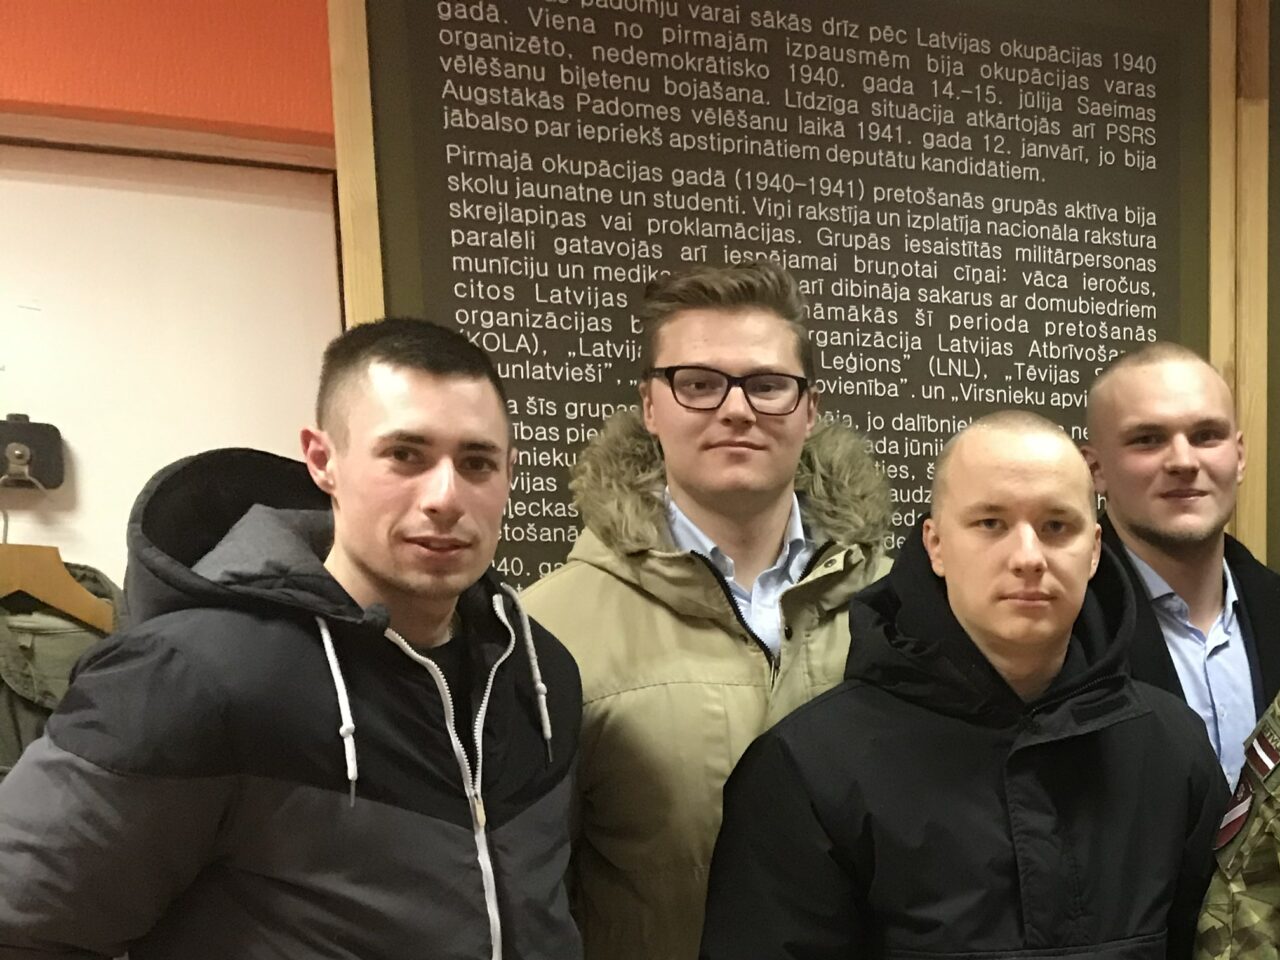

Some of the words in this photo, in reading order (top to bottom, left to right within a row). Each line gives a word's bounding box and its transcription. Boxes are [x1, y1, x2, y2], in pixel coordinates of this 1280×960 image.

[437, 0, 508, 24] gadā.
[528, 7, 596, 34] Viena
[615, 21, 643, 39] no
[663, 24, 767, 53] pirmajām
[786, 37, 909, 70] izpausmēm
[927, 54, 964, 77] bija
[980, 61, 1089, 90] okupācijas
[1104, 79, 1156, 98] varas
[688, 4, 740, 24] varai
[751, 10, 812, 33] sākās
[822, 17, 859, 38] drīz
[870, 25, 907, 44] pēc
[917, 28, 991, 54] Latvijas
[1000, 39, 1102, 68] okupācijas
[1114, 52, 1156, 74] 1940
[439, 29, 572, 59] organizēto,
[592, 45, 770, 79] nedemokrātisko
[789, 63, 845, 88] 1940.
[863, 75, 914, 95] gada
[932, 79, 1002, 104] 14.–15.
[1018, 88, 1062, 113] jūlija
[1078, 96, 1156, 122] Saeimas
[440, 54, 545, 82] vēlēšanu
[560, 64, 649, 93] biļetenu
[664, 75, 770, 105] bojāšana.
[785, 88, 859, 116] Līdzīga
[872, 98, 955, 126] situācija
[966, 109, 1060, 136] atkārtojās
[1072, 123, 1096, 139] arī
[1107, 123, 1156, 145] PSRS
[442, 79, 564, 111] Augstākās
[577, 92, 681, 122] Padomes
[691, 107, 787, 132] vēlēšanu
[798, 115, 845, 138] laikā
[858, 121, 911, 144] 1941.
[923, 131, 972, 150] gada
[984, 134, 1011, 154] 12.
[1020, 137, 1089, 164] janvārī,
[1098, 146, 1115, 166] jo
[1125, 148, 1157, 171] bija
[443, 106, 528, 133] jābalso
[535, 120, 571, 138] par
[577, 119, 663, 146] iepriekš
[669, 133, 820, 160] apstiprinātiem
[826, 144, 915, 169] deputātu
[921, 152, 1045, 182] kandidātiem.
[446, 144, 533, 173] Pirmajā
[542, 154, 663, 183] okupācijas
[672, 167, 726, 187] gadā
[735, 168, 864, 201] (1940–1941)
[873, 186, 984, 210] pretošanās
[992, 197, 1057, 216] grupās
[1065, 200, 1119, 222] aktīva
[1125, 205, 1157, 227] bija
[448, 172, 508, 195] skolu
[514, 176, 613, 204] jaunatne
[620, 189, 646, 206] un
[653, 190, 746, 214] studenti.
[752, 196, 791, 220] Viņi
[798, 202, 871, 226] rakstīja
[877, 211, 900, 227] un
[907, 209, 981, 236] izplatīja
[987, 219, 1079, 242] nacionāla
[1085, 226, 1157, 249] rakstura
[449, 198, 586, 229] skrejlapiņas
[601, 212, 632, 231] vai
[648, 216, 802, 245] proklamācijas.
[817, 227, 891, 251] Grupās
[905, 233, 1002, 260] iesaistītās
[1015, 244, 1156, 272] militārpersonas
[451, 228, 535, 250] paralēli
[554, 235, 662, 260] gatavojās
[680, 245, 708, 262] arī
[854, 254, 937, 279] bruņotai
[954, 264, 1006, 285] cīņai:
[1022, 270, 1068, 288] vāca
[1083, 272, 1155, 298] ieročus,
[452, 256, 548, 279] munīciju
[558, 263, 584, 279] un
[800, 278, 824, 295] arī
[831, 278, 911, 303] dibināja
[917, 285, 992, 307] sakarus
[1000, 294, 1018, 308] ar
[1025, 292, 1156, 319] domubiedriem
[454, 278, 515, 301] citos
[535, 283, 628, 309] Latvijas
[455, 308, 612, 334] organizācijas
[808, 328, 922, 352] rganizācija
[938, 333, 1013, 357] Latvijas
[915, 308, 933, 327] šī
[950, 312, 1029, 333] perioda
[1045, 319, 1156, 342] pretošanās
[821, 350, 910, 373] Leģions”
[929, 355, 987, 381] (LNL),
[1005, 361, 1080, 385] „Tēvijas
[922, 385, 945, 400] un
[951, 382, 1045, 407] „Virsnieku
[526, 396, 557, 416] šīs
[867, 411, 885, 432] jo
